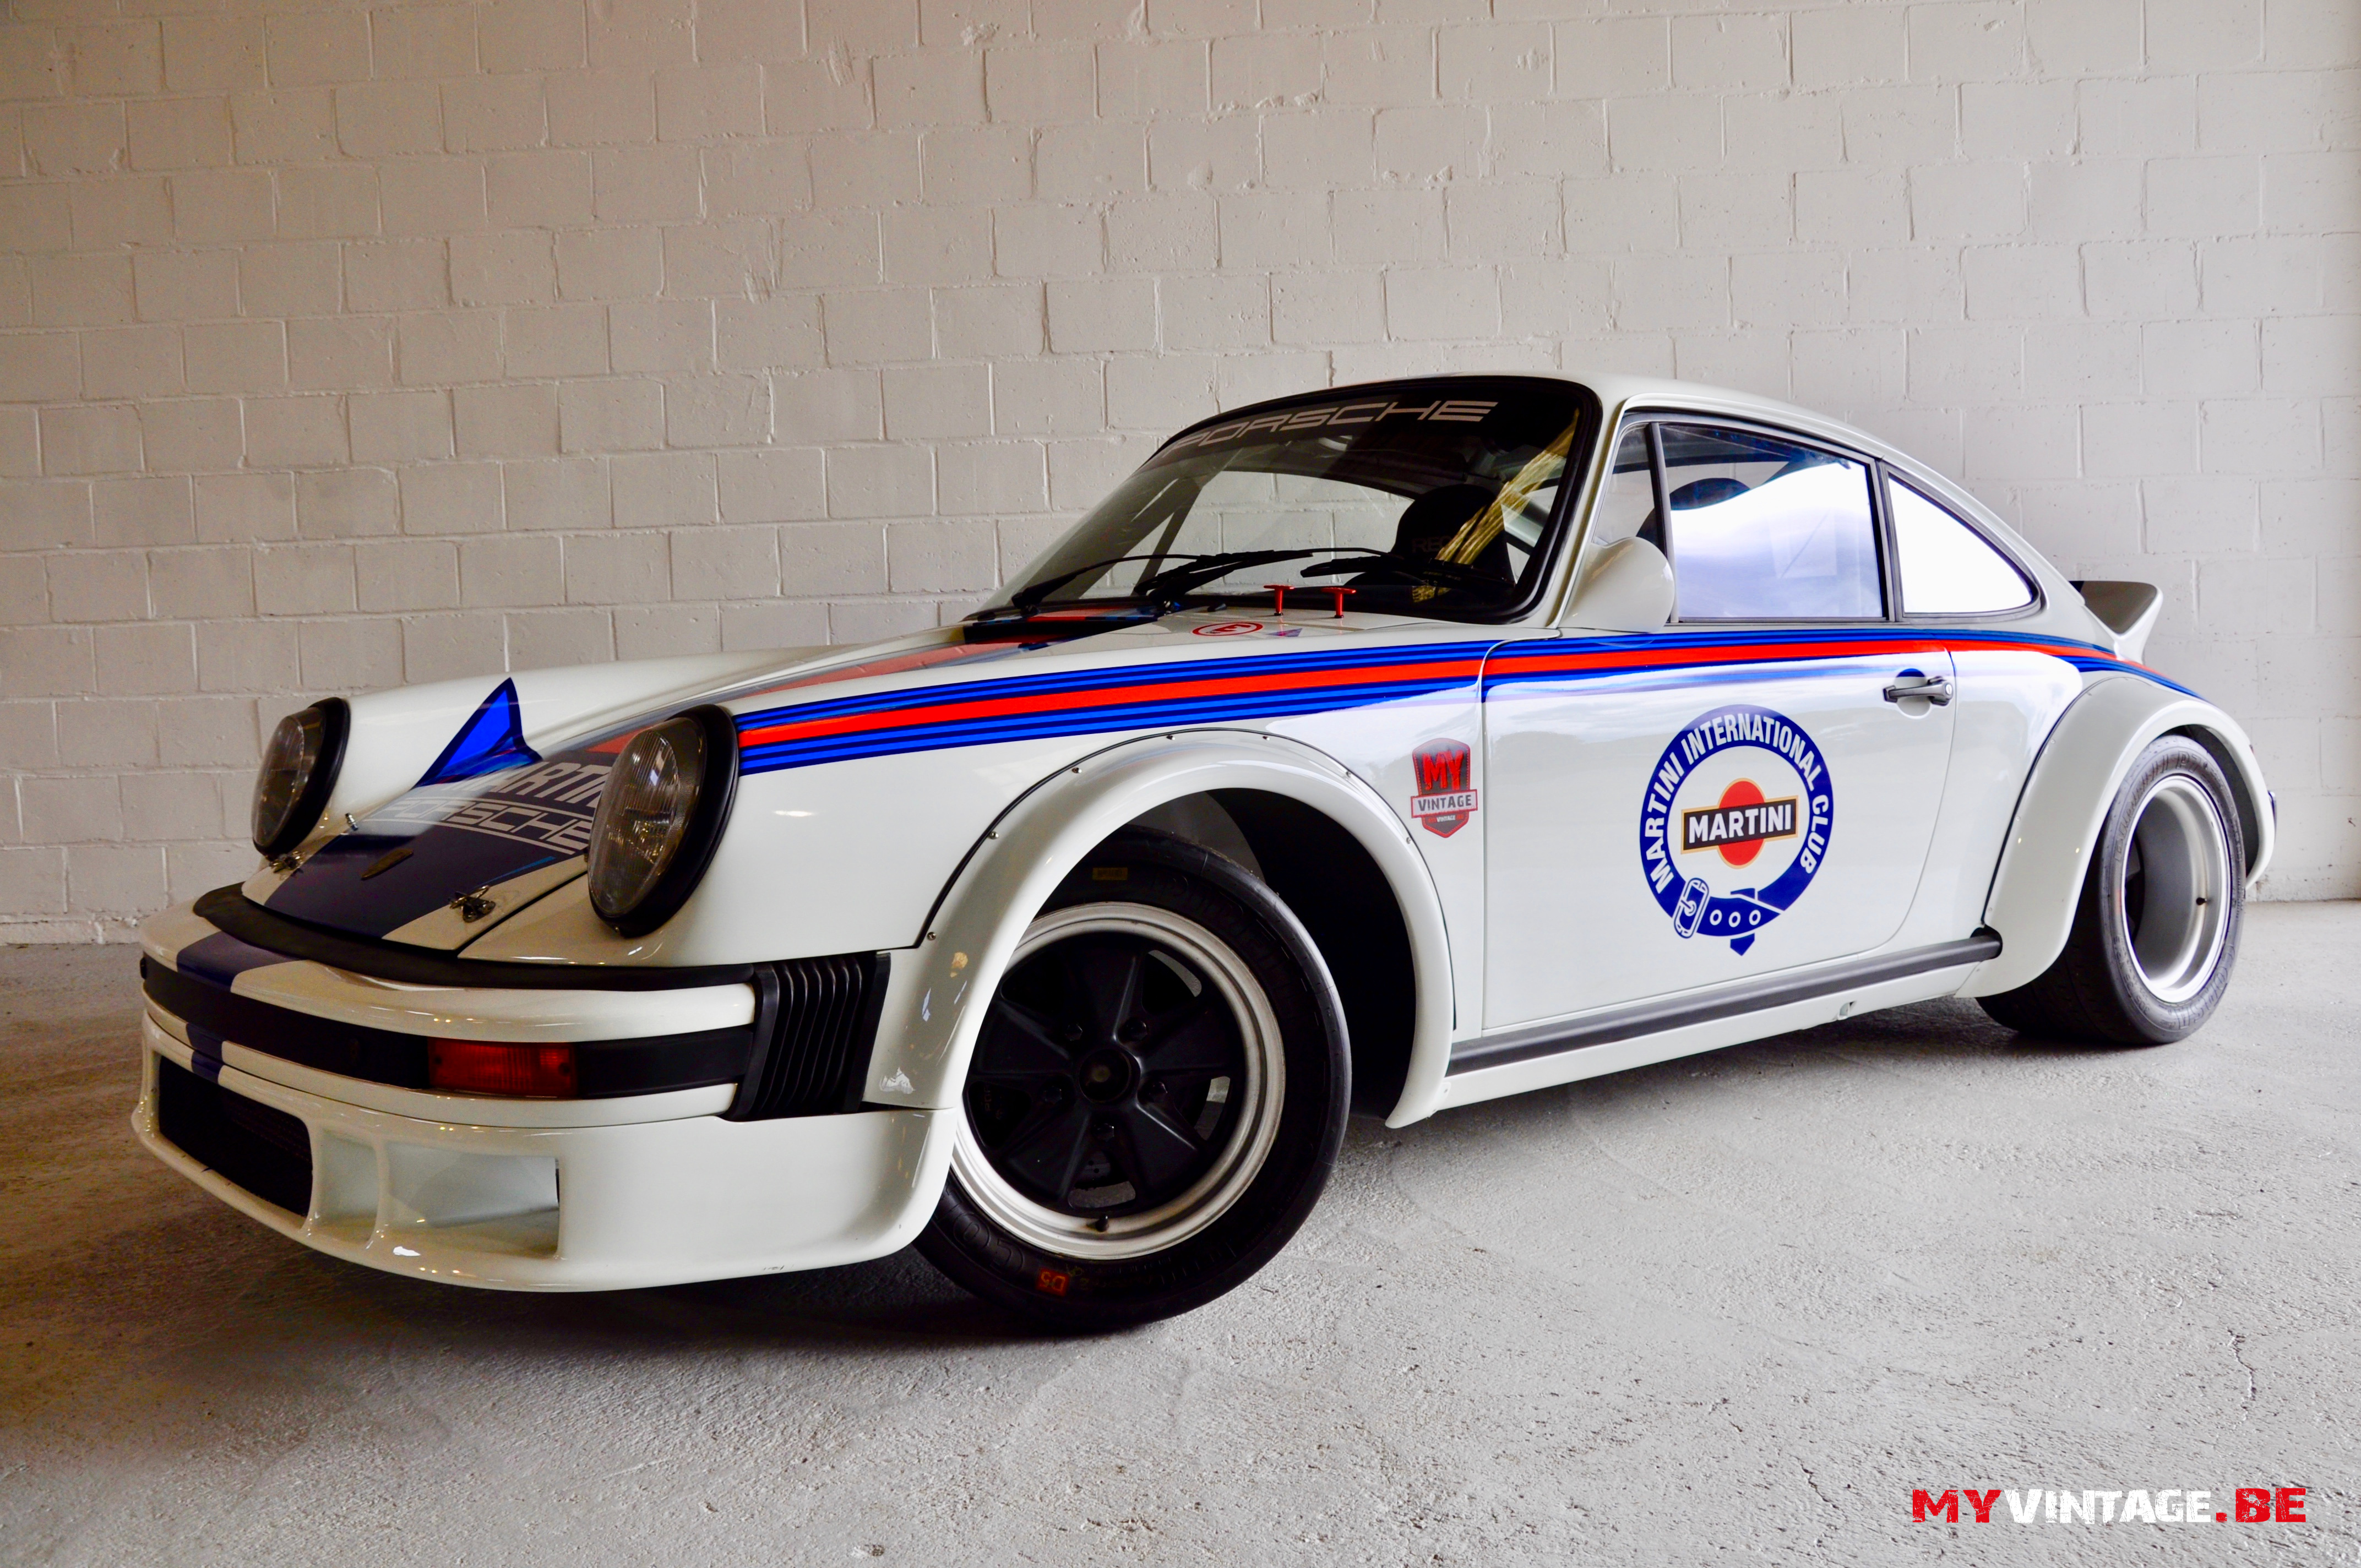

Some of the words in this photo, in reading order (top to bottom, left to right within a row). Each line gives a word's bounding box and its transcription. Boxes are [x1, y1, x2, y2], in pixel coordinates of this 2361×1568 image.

[1162, 400, 1499, 458] PORSCHE
[440, 761, 612, 809] ARTI
[1421, 749, 1464, 791] MY
[370, 799, 592, 851] PORSCHE
[1418, 794, 1472, 812] VINTAGE
[1645, 752, 1685, 894] MARTINI
[1680, 713, 1822, 792] INTERNATIONAL
[1800, 794, 1829, 874] CLUB
[1689, 804, 1792, 843] MARTINI
